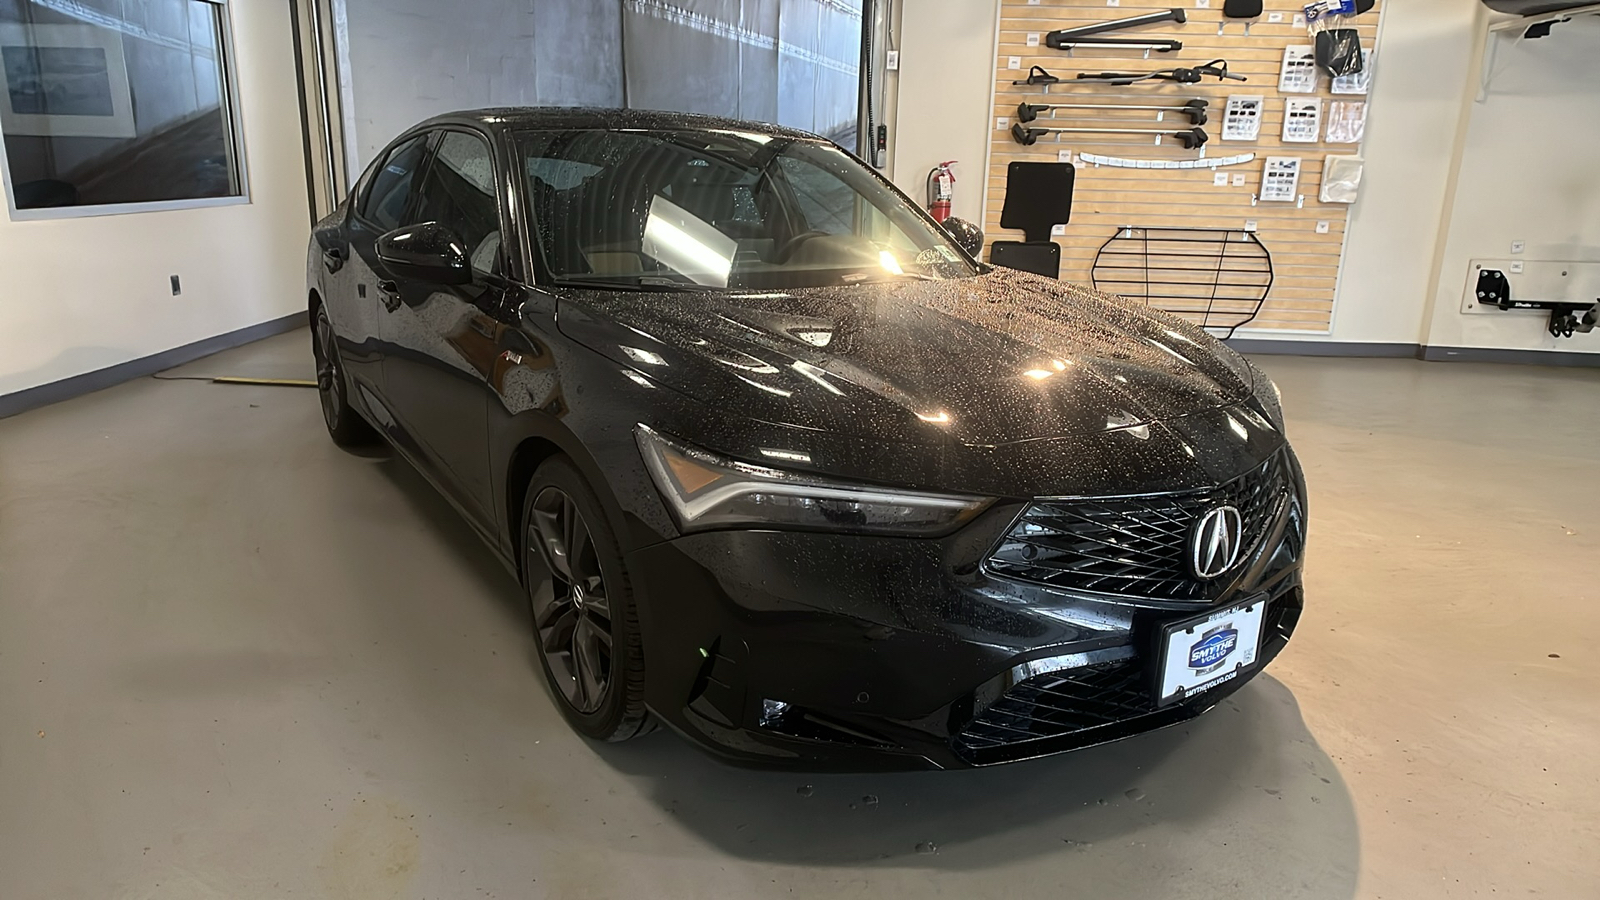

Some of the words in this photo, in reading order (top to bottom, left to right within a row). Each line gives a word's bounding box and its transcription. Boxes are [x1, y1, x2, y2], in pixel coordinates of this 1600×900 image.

[1191, 638, 1235, 662] SMYTHE
[1201, 649, 1227, 664] VOLVO
[1184, 671, 1237, 698] SMYTHEVOLVO.COM
